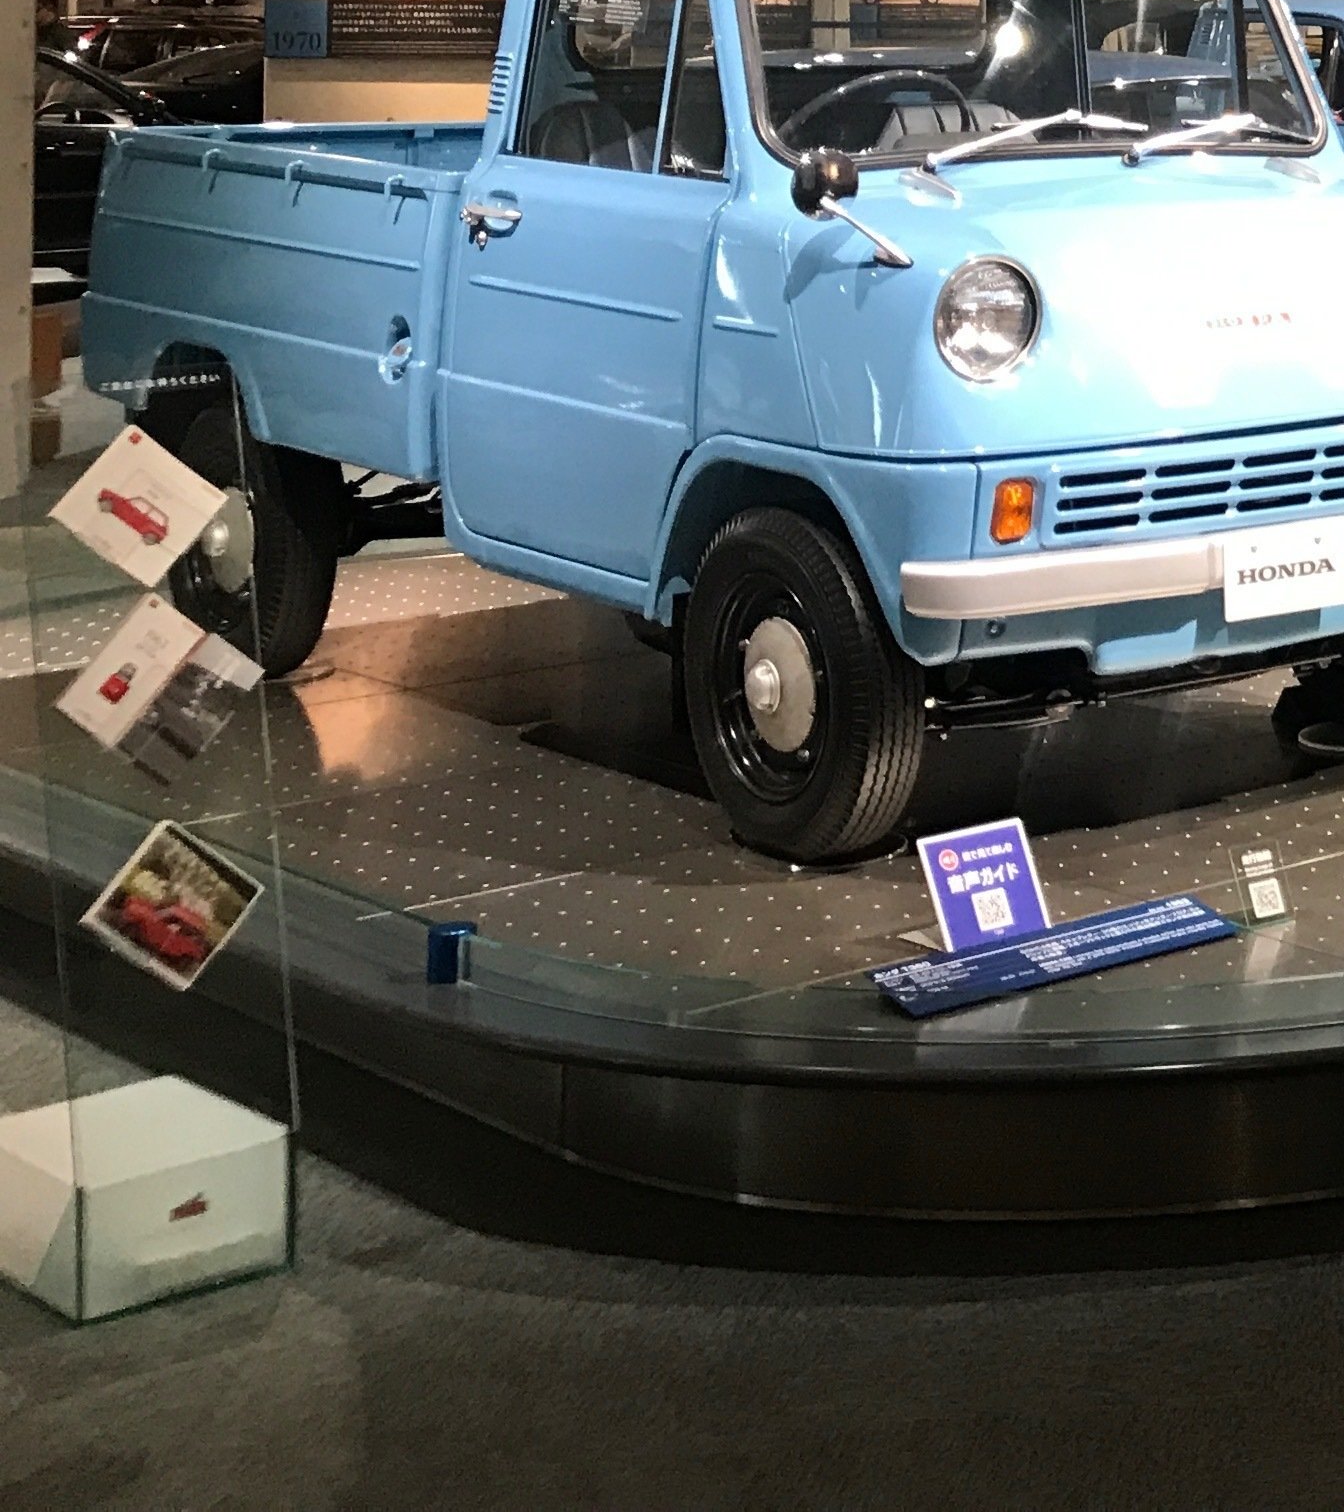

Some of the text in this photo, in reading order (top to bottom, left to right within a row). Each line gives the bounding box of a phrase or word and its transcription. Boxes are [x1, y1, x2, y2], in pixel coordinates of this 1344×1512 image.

[273, 30, 321, 51] 1970
[1236, 557, 1336, 586] HONDA
[946, 861, 1020, 894] 音声ガイド
